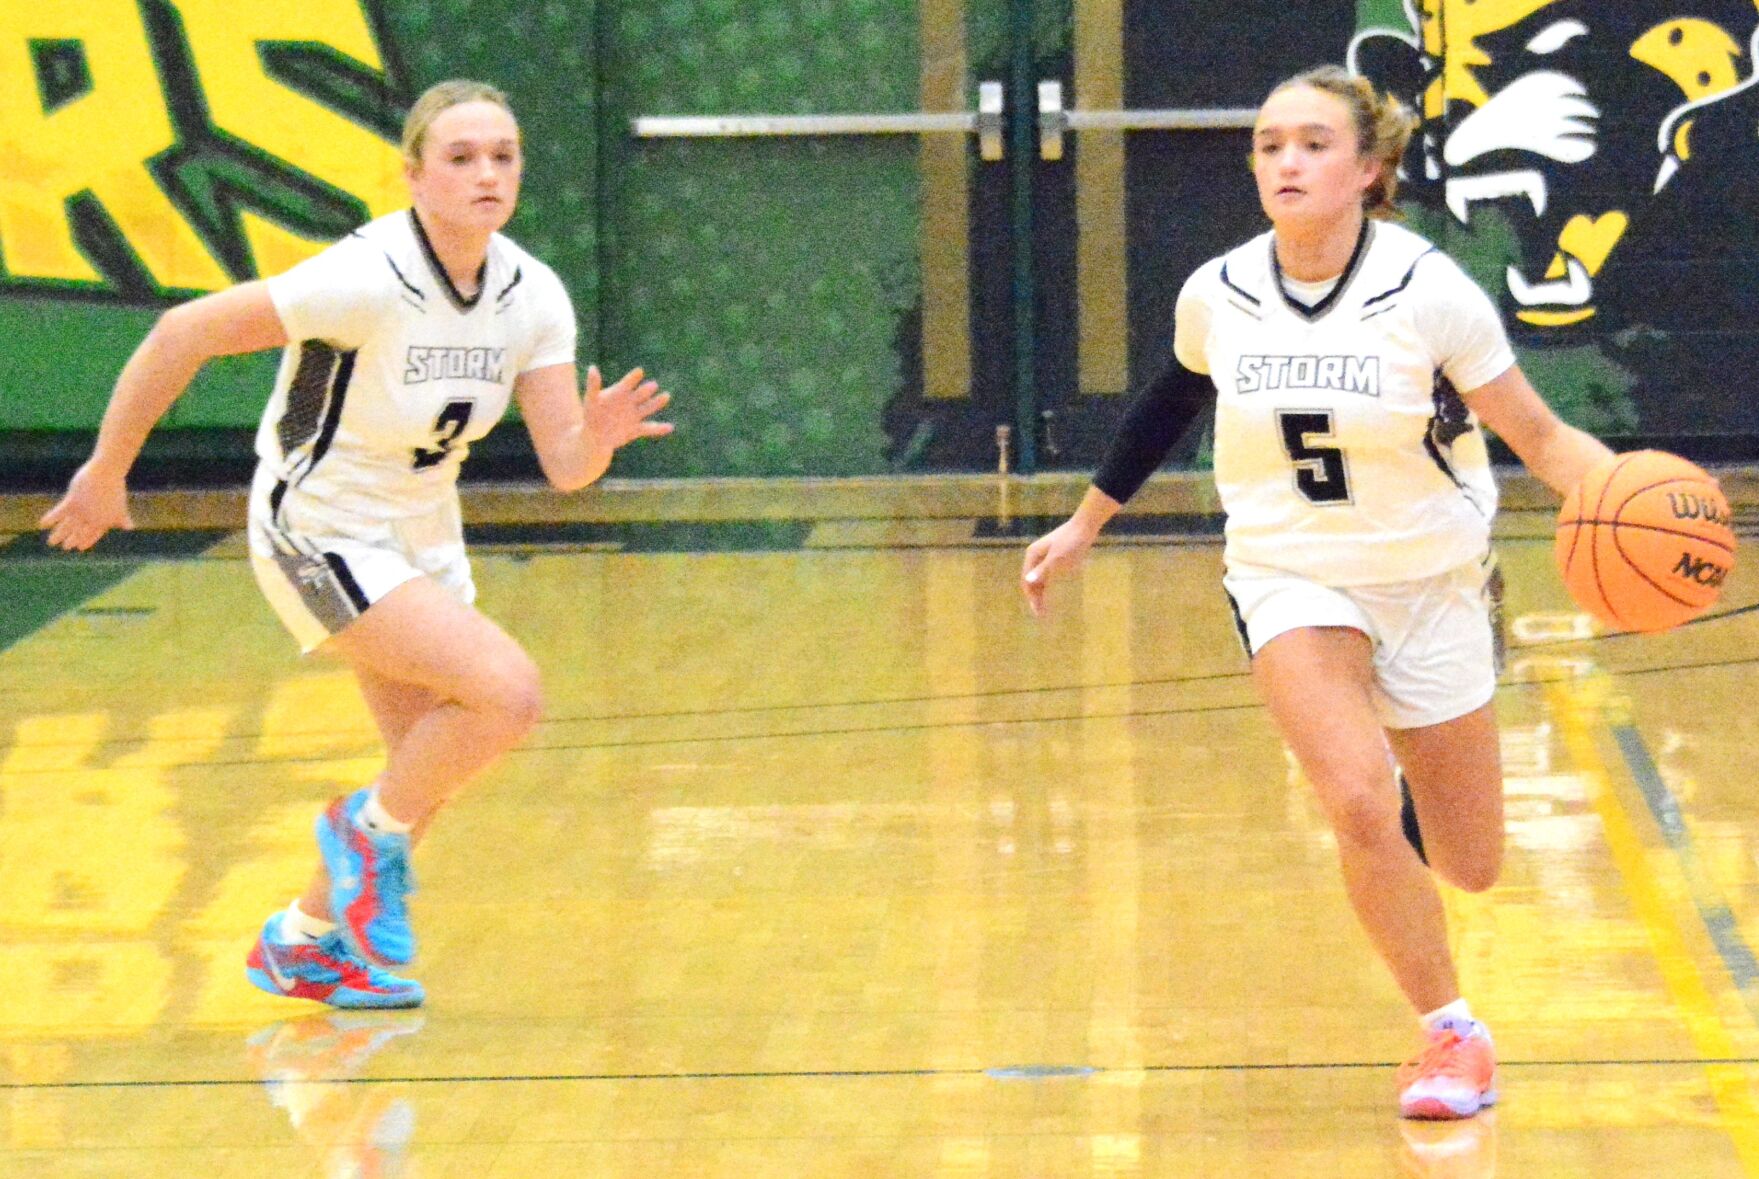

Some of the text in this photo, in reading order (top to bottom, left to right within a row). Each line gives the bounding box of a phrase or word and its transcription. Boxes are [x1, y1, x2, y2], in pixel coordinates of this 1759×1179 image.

[404, 345, 506, 385] STORM
[1236, 355, 1380, 398] STORM
[1276, 410, 1353, 505] 5
